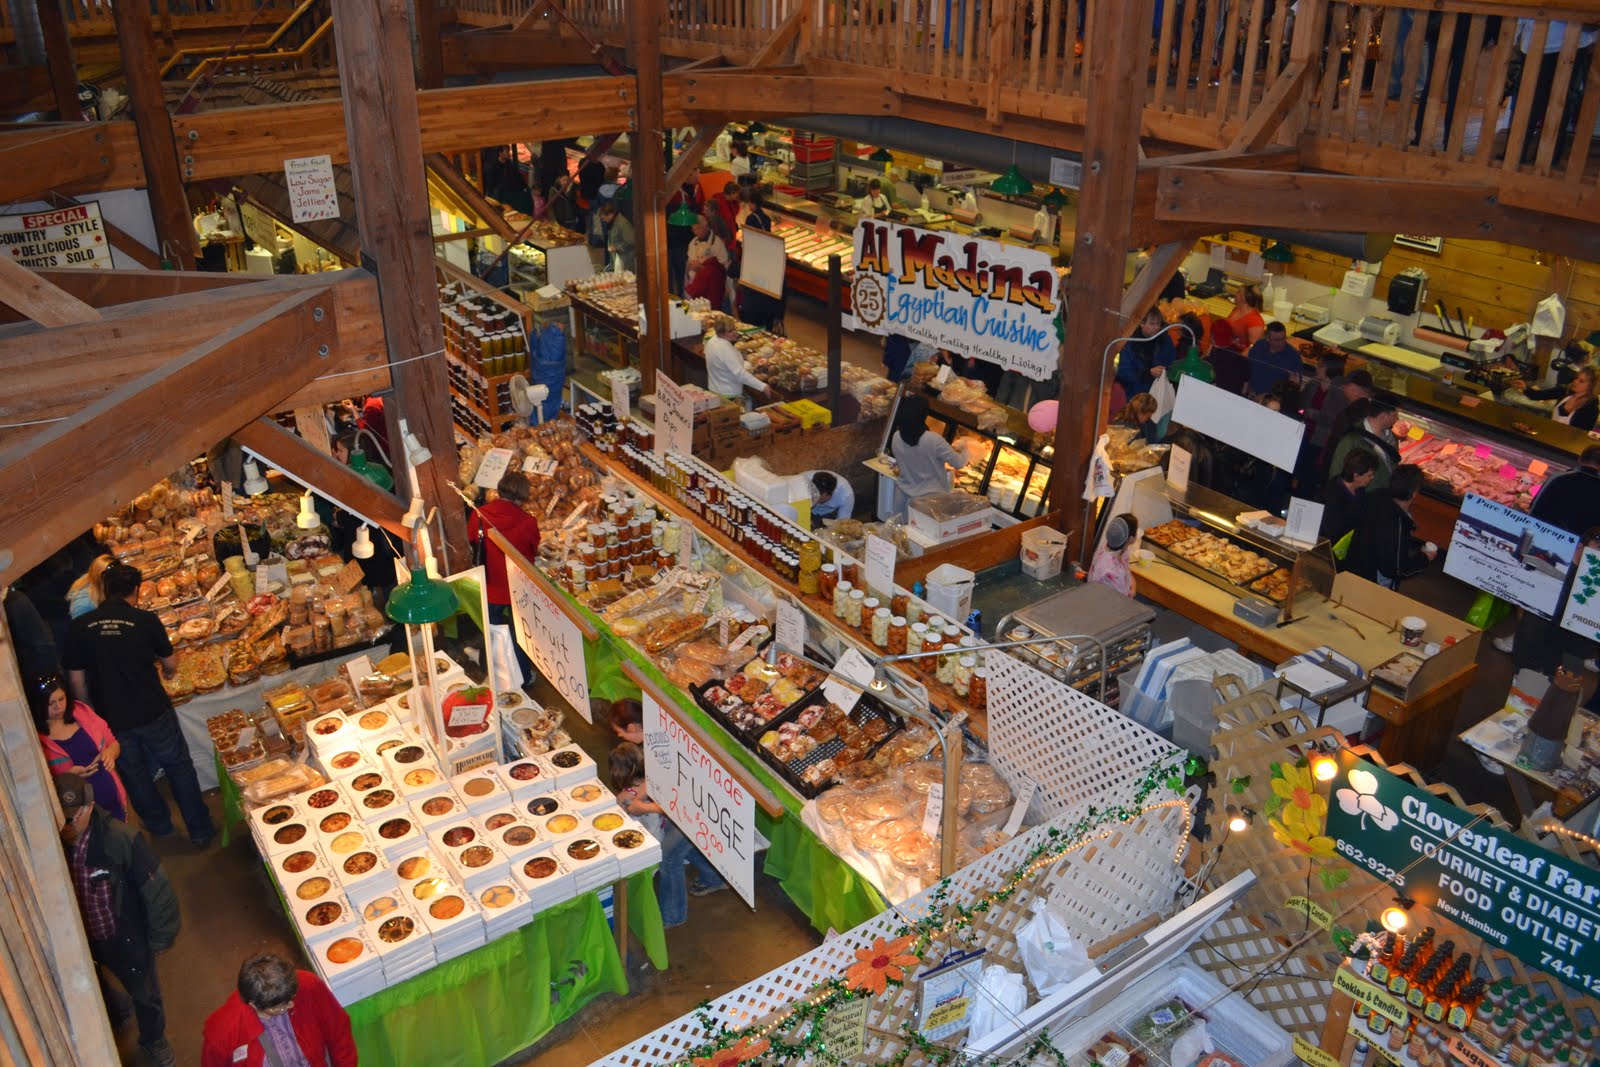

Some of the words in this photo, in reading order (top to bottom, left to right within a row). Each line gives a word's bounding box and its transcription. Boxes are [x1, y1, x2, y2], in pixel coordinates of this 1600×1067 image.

[290, 178, 307, 187] Low
[308, 175, 332, 187] Sugar
[298, 187, 320, 197] Jams
[28, 208, 85, 228] SPECIAL
[297, 198, 326, 208] Jellies
[64, 219, 99, 236] STYLE
[21, 237, 80, 257] DELICIOUS
[66, 249, 94, 264] SOLD
[857, 221, 892, 275] Al
[897, 228, 1056, 314] Madina
[859, 289, 879, 311] 25
[886, 272, 968, 330] Egyptian
[972, 296, 1050, 351] Cuisine
[908, 324, 938, 344] Healthy
[940, 334, 970, 354] Eating
[973, 345, 1007, 365] Healthy
[1476, 498, 1500, 513] Pure
[1502, 509, 1532, 525] Maple
[1533, 522, 1566, 540] Syrup
[533, 602, 570, 663] Fruit
[1572, 613, 1600, 629] PRODU
[456, 752, 493, 773] HOMEMADE
[659, 706, 744, 805] Homemade
[669, 788, 681, 822] 2
[677, 751, 745, 860] FUDGE
[1336, 838, 1406, 887] 662-9225
[1401, 795, 1546, 880] Cloverleaf
[1545, 864, 1600, 909] Far
[1410, 834, 1506, 894] GOURMET
[1508, 884, 1522, 903] &
[1437, 898, 1459, 918] New
[1460, 906, 1508, 945] Hamburg
[1438, 873, 1493, 912] FOOD
[1501, 906, 1582, 957] OUTLET
[1337, 975, 1365, 999] Cookies
[1372, 994, 1404, 1020] Candies
[832, 1008, 863, 1024] Natural
[1295, 1036, 1312, 1053] Sugar
[1314, 1050, 1332, 1062] Free
[1352, 1028, 1378, 1048] Sugar
[1378, 1046, 1398, 1062] Free
